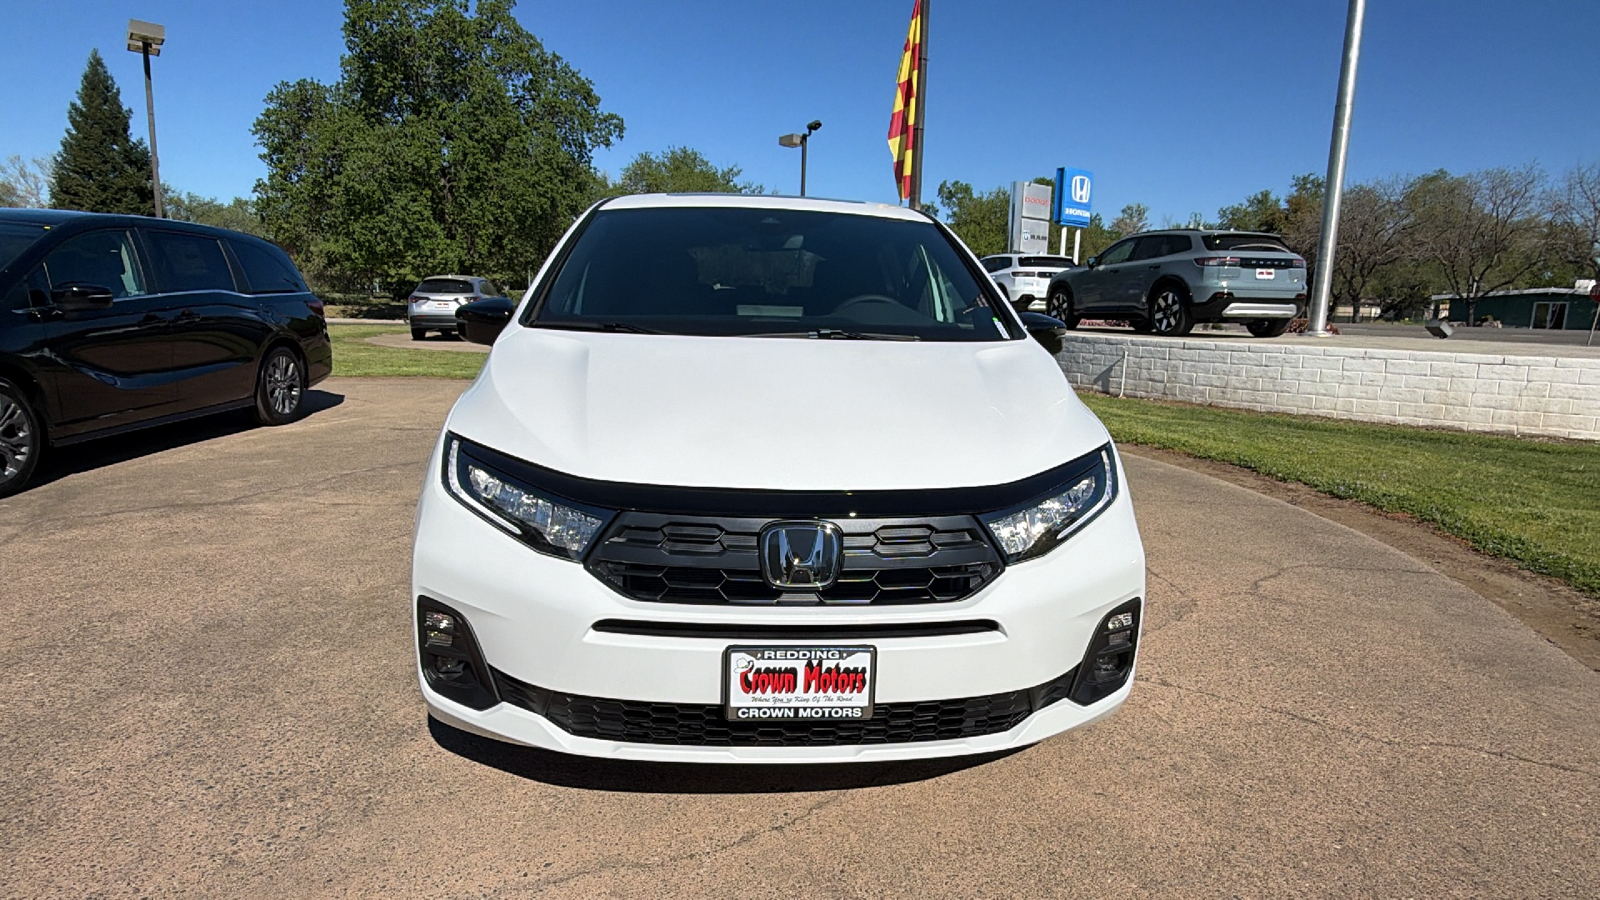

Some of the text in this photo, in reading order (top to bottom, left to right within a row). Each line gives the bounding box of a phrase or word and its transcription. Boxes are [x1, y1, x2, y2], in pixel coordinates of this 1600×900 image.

[1065, 207, 1090, 218] HONDA
[764, 650, 840, 659] REDDING
[739, 659, 867, 694] Crown Motors
[737, 707, 862, 718] CROWN MOTORS
